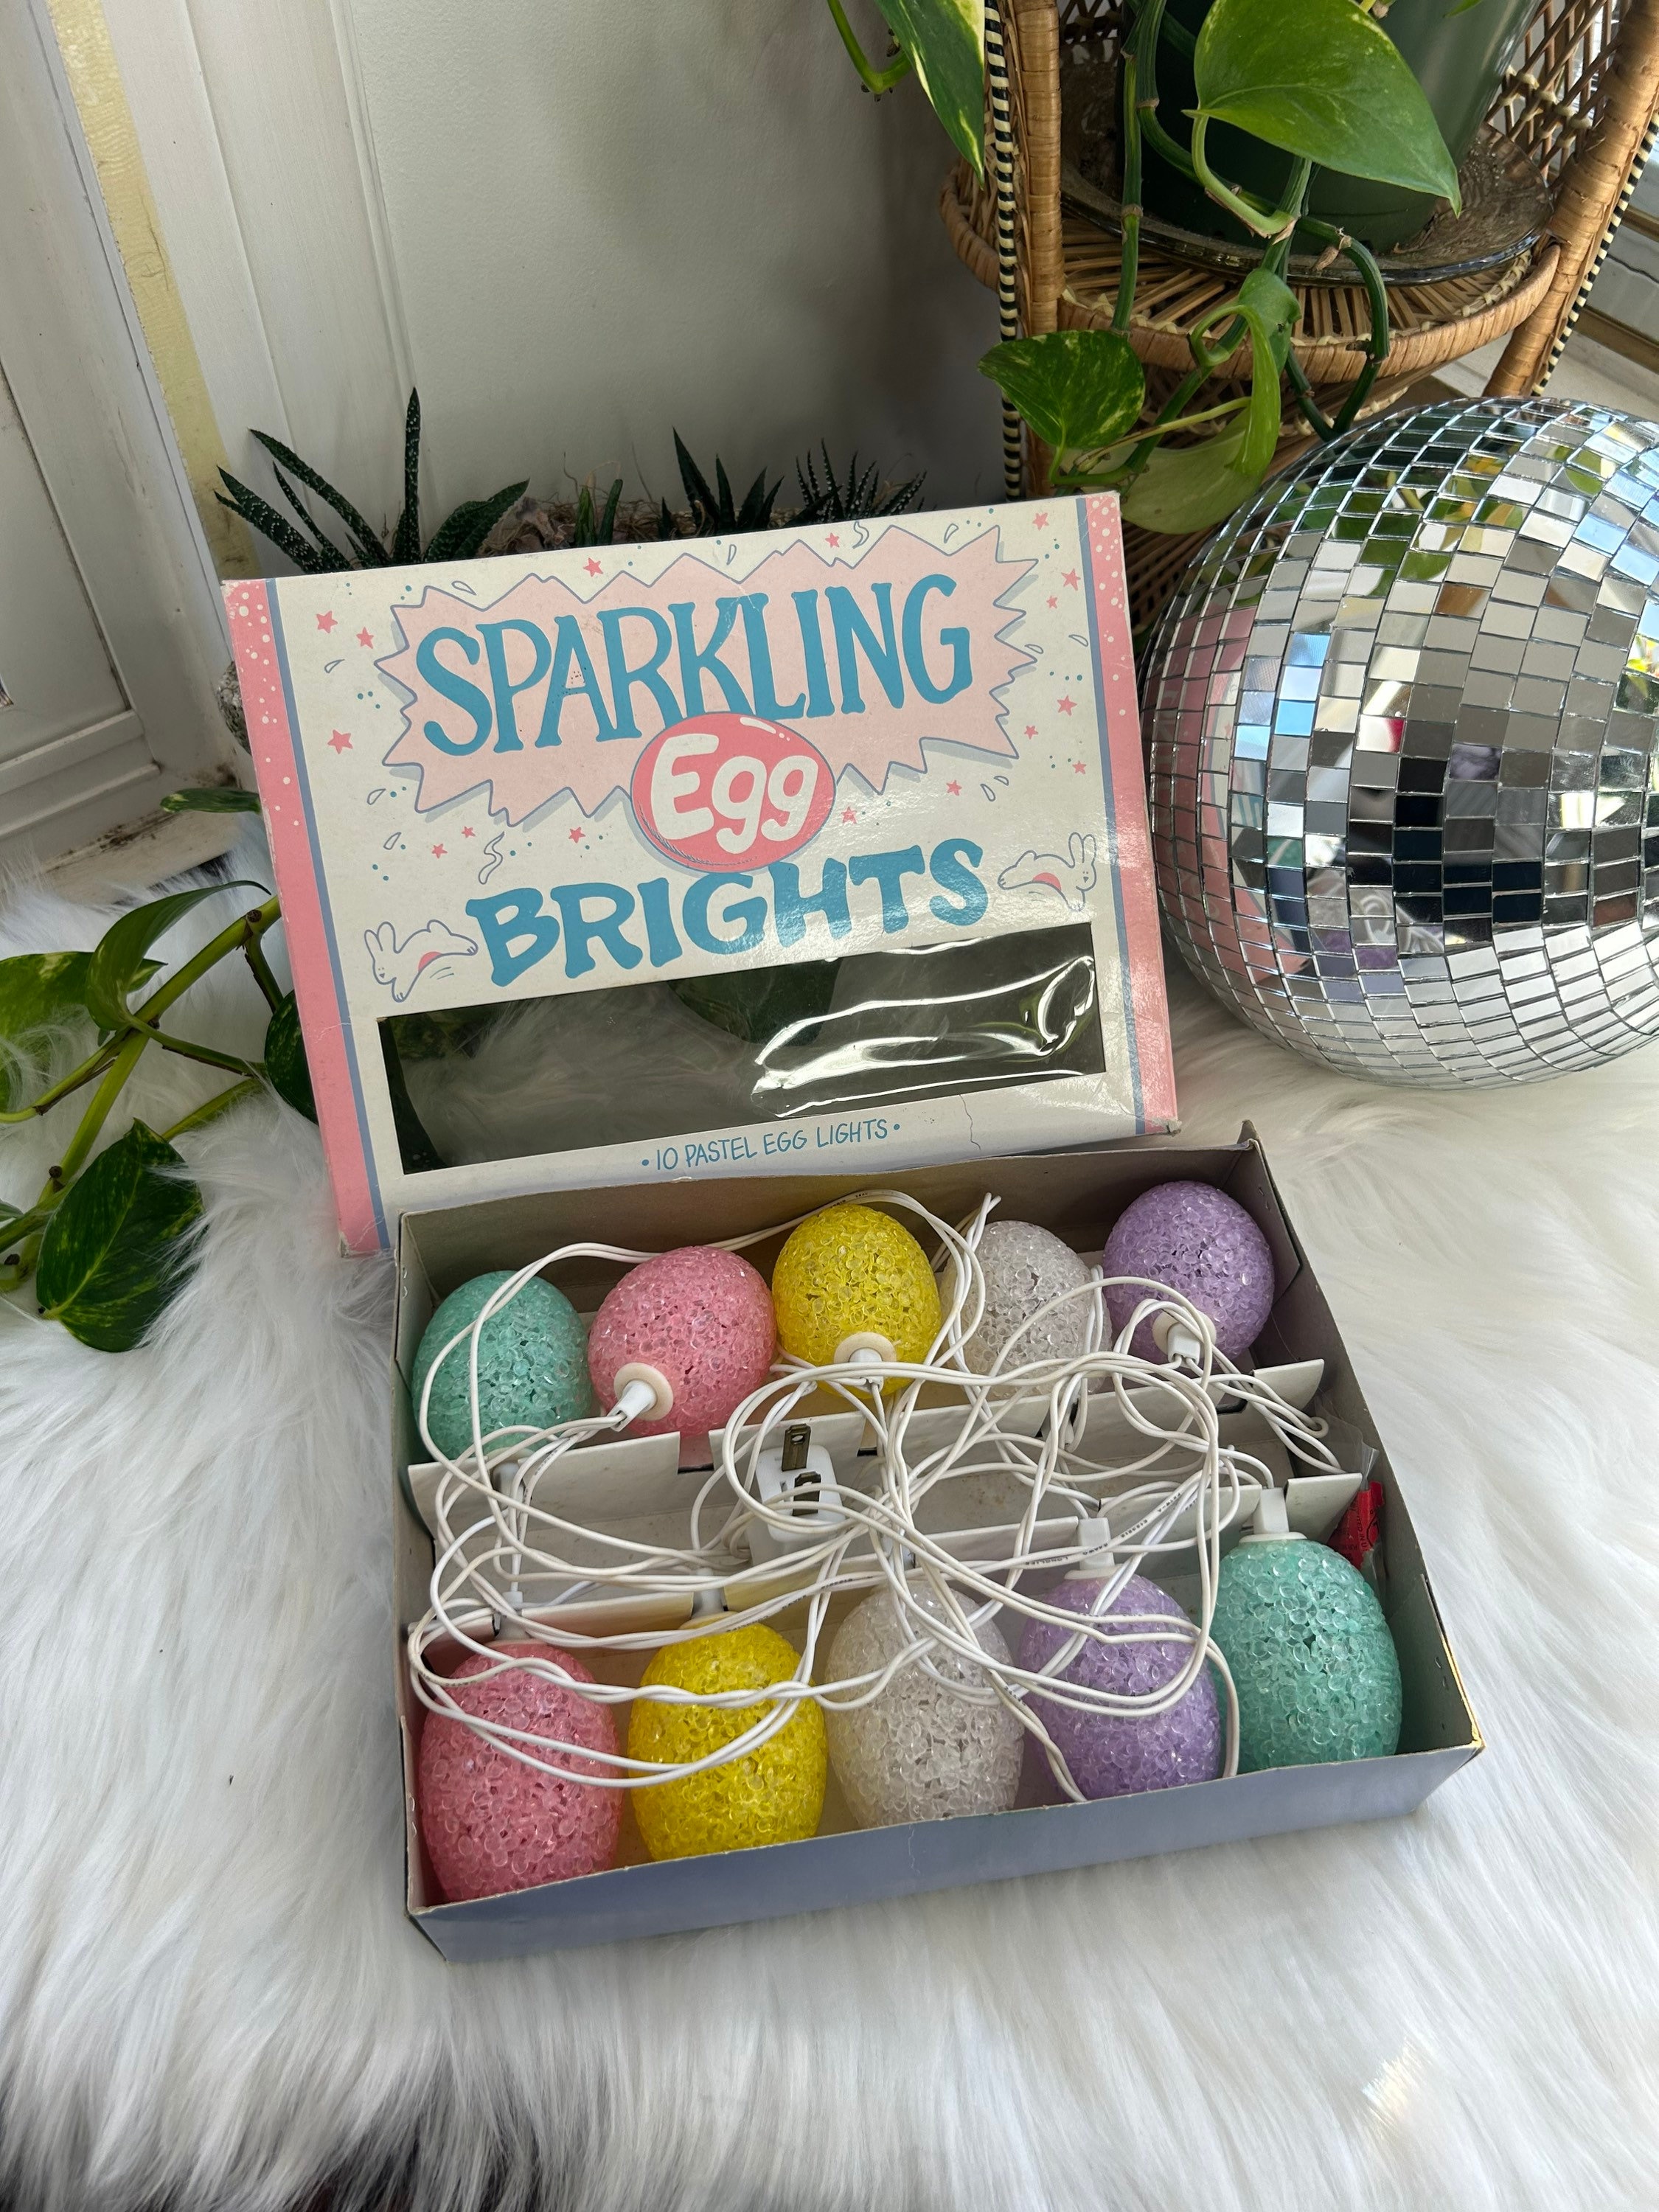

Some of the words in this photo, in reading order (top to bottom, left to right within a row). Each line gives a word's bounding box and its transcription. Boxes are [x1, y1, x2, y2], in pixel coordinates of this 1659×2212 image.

[415, 574, 973, 757] SPARKLING
[650, 733, 818, 855] Egg
[465, 838, 990, 988] BRIGHTS
[656, 1147, 679, 1171] 10
[684, 1136, 758, 1168] PASTEL
[762, 1130, 808, 1155] EGG
[816, 1119, 889, 1148] LIGHTS
